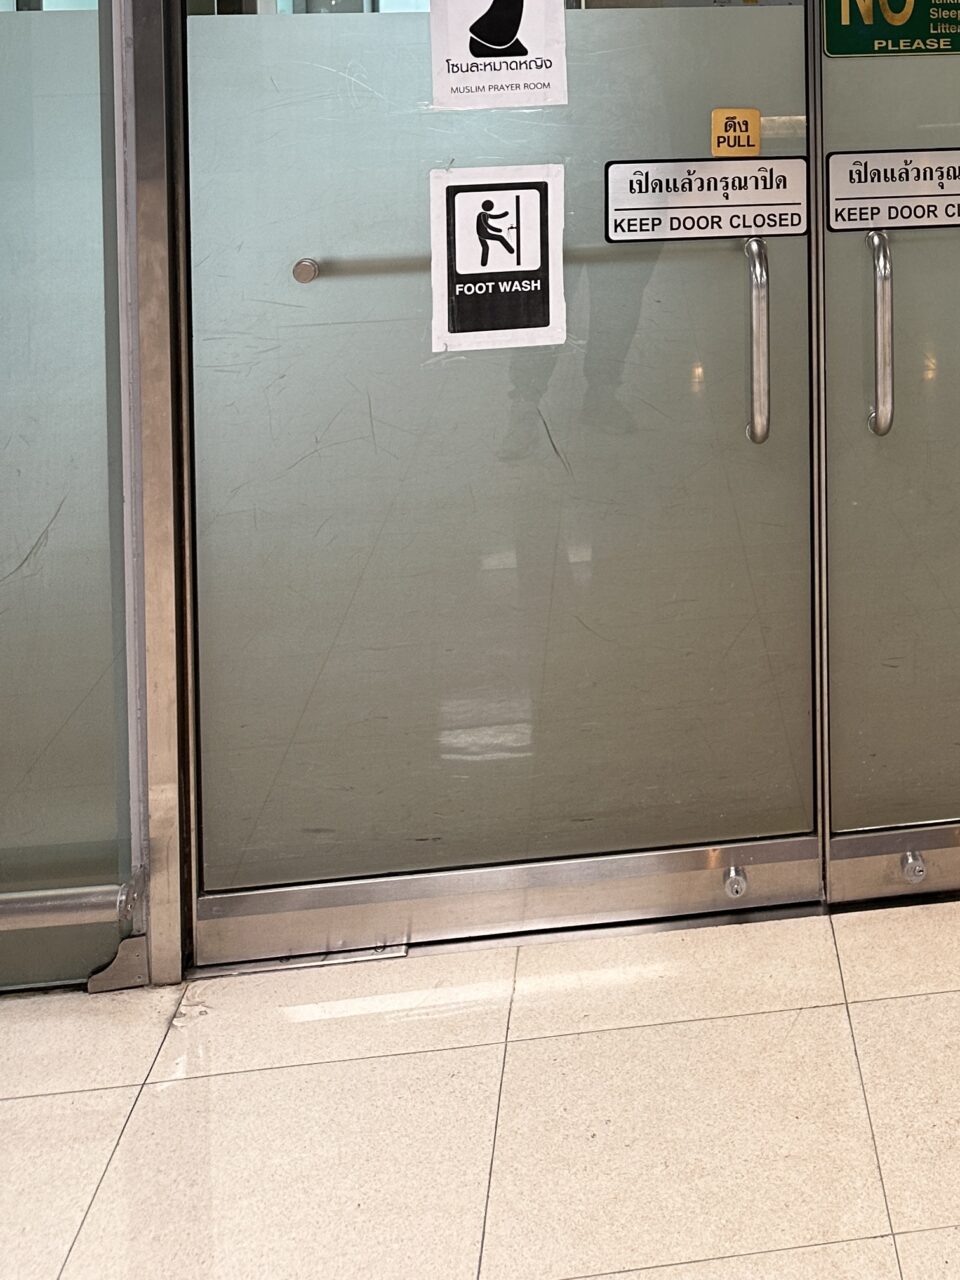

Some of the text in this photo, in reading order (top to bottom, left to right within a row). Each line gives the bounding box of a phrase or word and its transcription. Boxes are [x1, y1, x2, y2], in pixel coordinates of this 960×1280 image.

[874, 38, 952, 50] PLEASE
[446, 56, 552, 73] โซนละหมาดหญิง
[451, 82, 550, 94] MUSLIM PRAYER ROOM
[724, 116, 748, 132] ดึง
[717, 135, 756, 148] PULL
[630, 167, 786, 200] เปิดแล้วกรุณาปิด
[835, 207, 880, 222] KEEP
[888, 205, 938, 220] DOOR
[614, 213, 801, 232] KEEP DOOR CLOSED
[456, 280, 540, 295] FOOT WASH
